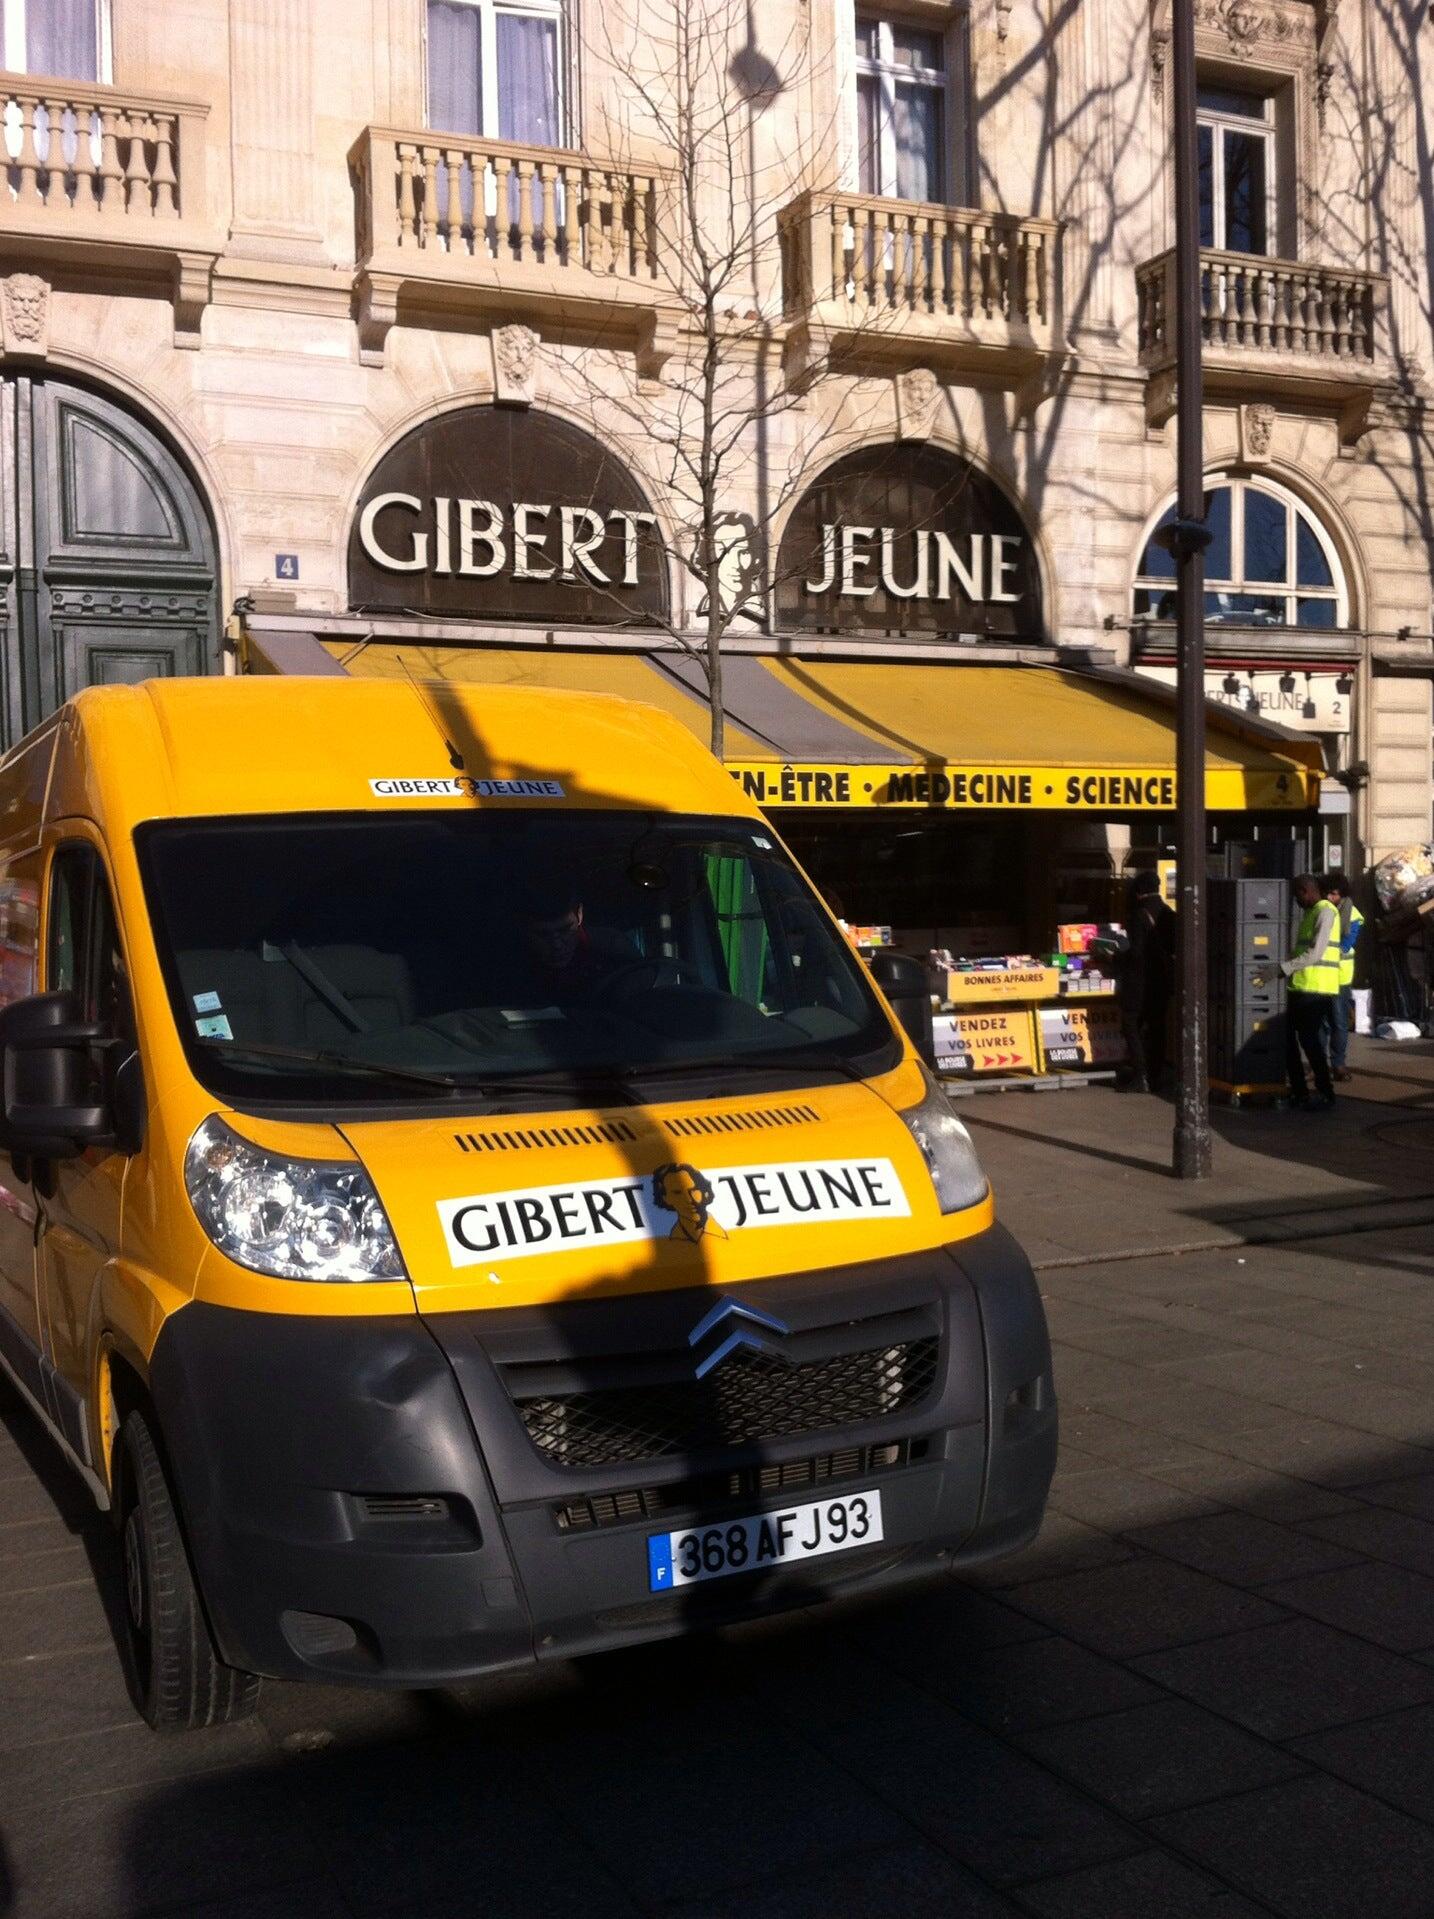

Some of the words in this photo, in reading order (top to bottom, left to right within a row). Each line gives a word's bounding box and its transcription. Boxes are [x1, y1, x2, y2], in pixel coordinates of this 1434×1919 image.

[359, 492, 657, 586] GIBERT
[806, 523, 1024, 602] JEUNE
[280, 557, 294, 576] 4
[1332, 701, 1342, 714] 2
[374, 780, 451, 795] GIBERT
[481, 780, 558, 796] JEUNE
[887, 773, 1032, 804] MEDECINE
[1065, 775, 1177, 805] SCIENCE
[964, 975, 1002, 985] BONNES
[1003, 973, 1044, 984] AFFAIRES
[949, 1018, 1007, 1032] VENDEZ
[948, 1038, 972, 1050] VOS
[976, 1036, 1016, 1048] LIVRES
[1060, 1031, 1083, 1043] VOS
[451, 1183, 645, 1252] GIBERT
[717, 1165, 892, 1226] JEUNE
[678, 1524, 749, 1578] 368
[827, 1497, 870, 1545] 93
[657, 1567, 665, 1581] F
